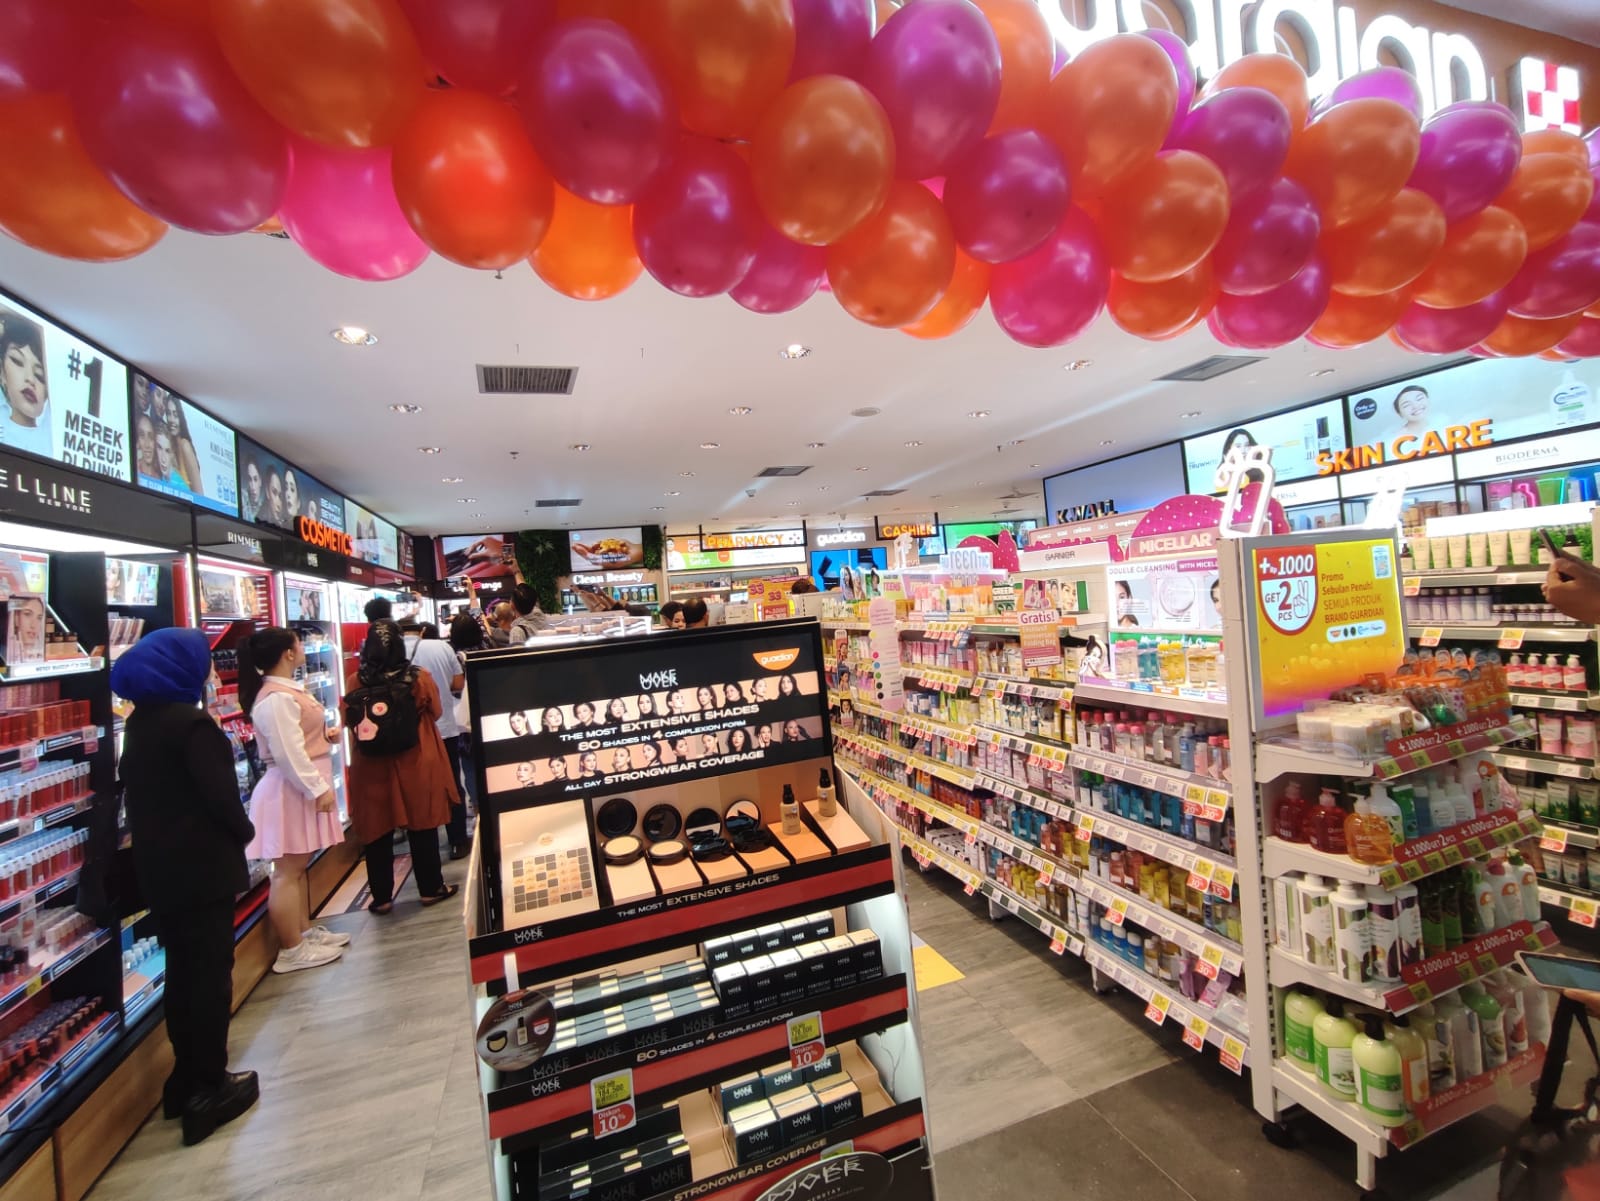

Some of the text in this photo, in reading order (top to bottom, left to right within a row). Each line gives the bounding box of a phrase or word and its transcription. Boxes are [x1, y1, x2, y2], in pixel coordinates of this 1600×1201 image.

[65, 409, 124, 450] MEREK
[63, 431, 123, 466] MAKEUP
[1315, 417, 1493, 476] SKIN CARE
[1495, 445, 1560, 463] BIODERMA
[39, 497, 91, 515] NEW YORK
[300, 514, 354, 558] COSMETICS
[817, 530, 866, 546] guardian
[882, 523, 933, 538] CASHIER
[228, 532, 260, 550] RIMMEL
[706, 533, 784, 548] PHARMACY
[1139, 532, 1213, 554] MICELLAR
[1045, 551, 1076, 561] GARNIER
[1136, 563, 1176, 573] CLEANSING
[572, 571, 644, 585] Clean Beauty
[1321, 573, 1344, 583] Promo
[1265, 580, 1292, 611] GET 2
[1322, 583, 1349, 596] Sebulan
[1323, 594, 1382, 611] SEMUA PRODUK
[1020, 610, 1055, 624] Gratis!
[1278, 611, 1293, 621] PCS
[1325, 607, 1384, 624] BRAND GUARDIAN
[760, 652, 794, 665] guardian
[560, 704, 760, 742] THE MOST EXTENSIVE SHADES
[602, 737, 640, 748] SHADES
[641, 734, 651, 742] IN
[652, 730, 664, 740] 4
[665, 723, 721, 738] COMPLEXION
[722, 719, 747, 729] FORM
[564, 750, 765, 792] ALL DAY STRONGWEAR COVERAGE
[617, 873, 780, 918] THE MOST EXTENSIVE SHADES
[659, 1041, 694, 1056] SHADES
[696, 1038, 705, 1046] IN
[706, 1032, 716, 1041] 4
[717, 1019, 771, 1039] COMPLEXION
[771, 1010, 794, 1022] FORM
[794, 1044, 814, 1055] Diskon
[598, 1107, 621, 1120] Diskon
[674, 1138, 828, 1201] STRONGWEAR COVERAGE
